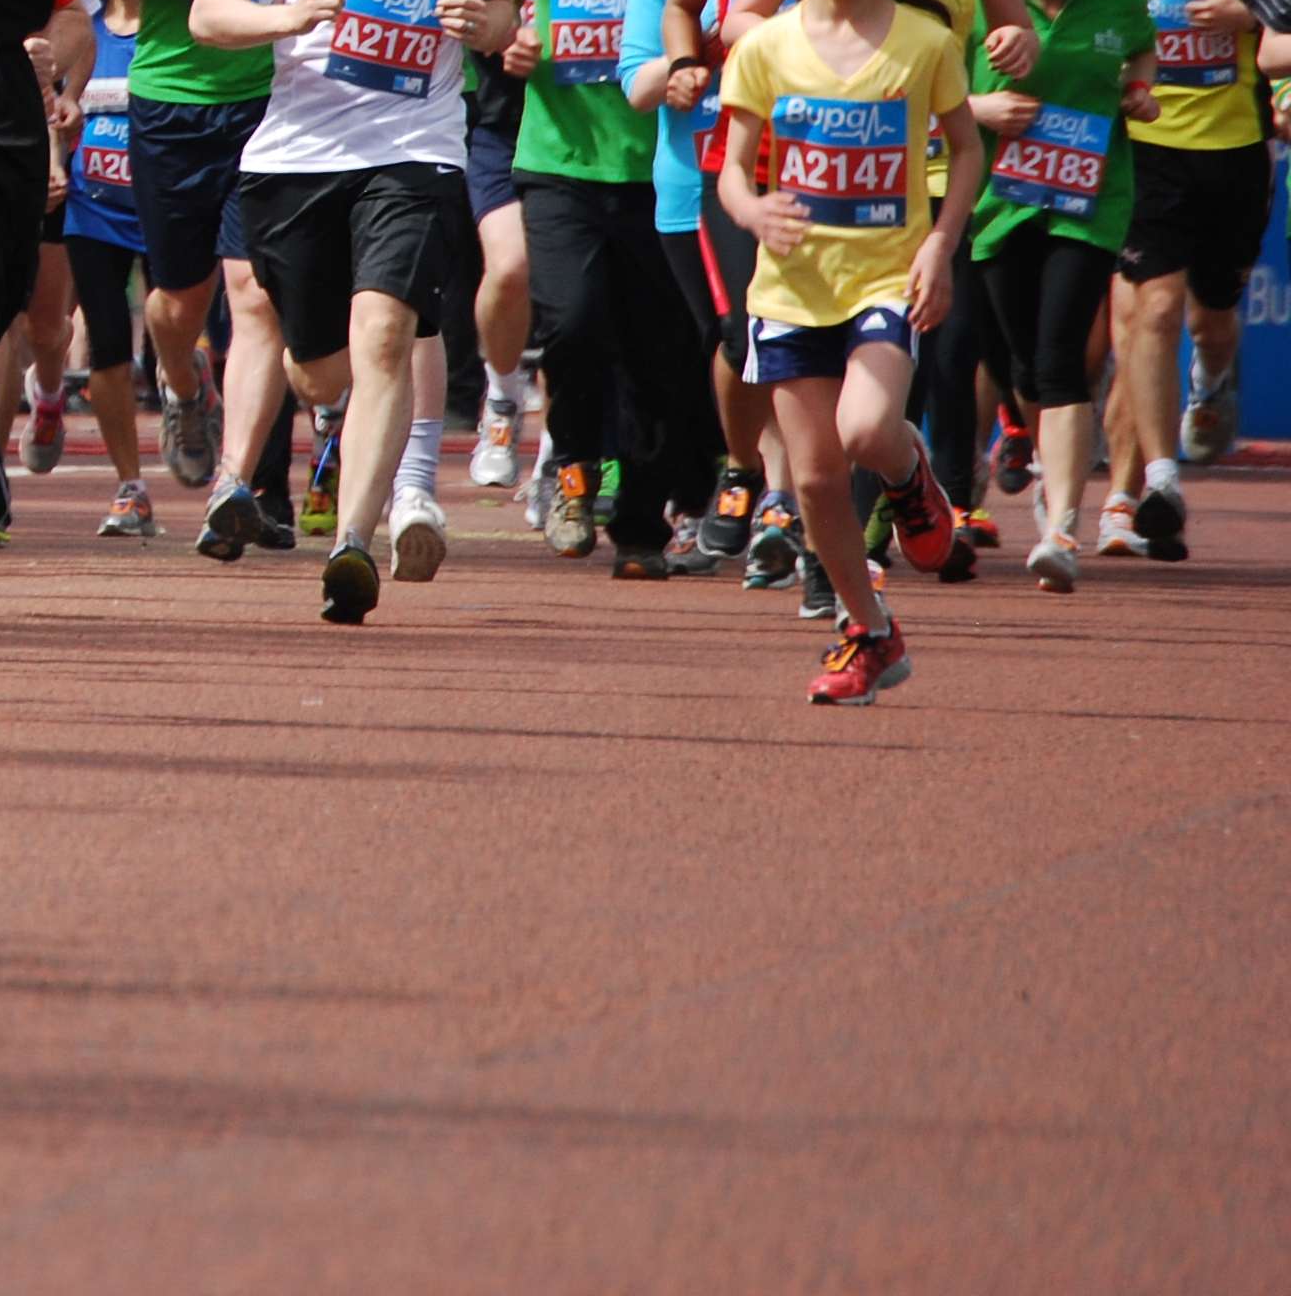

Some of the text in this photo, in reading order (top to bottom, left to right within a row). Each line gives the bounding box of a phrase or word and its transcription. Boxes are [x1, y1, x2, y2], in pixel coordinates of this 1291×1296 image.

[334, 15, 438, 67] A2178
[785, 96, 868, 138] Bupa
[780, 144, 904, 192] A2147
[997, 140, 1100, 189] A2183
